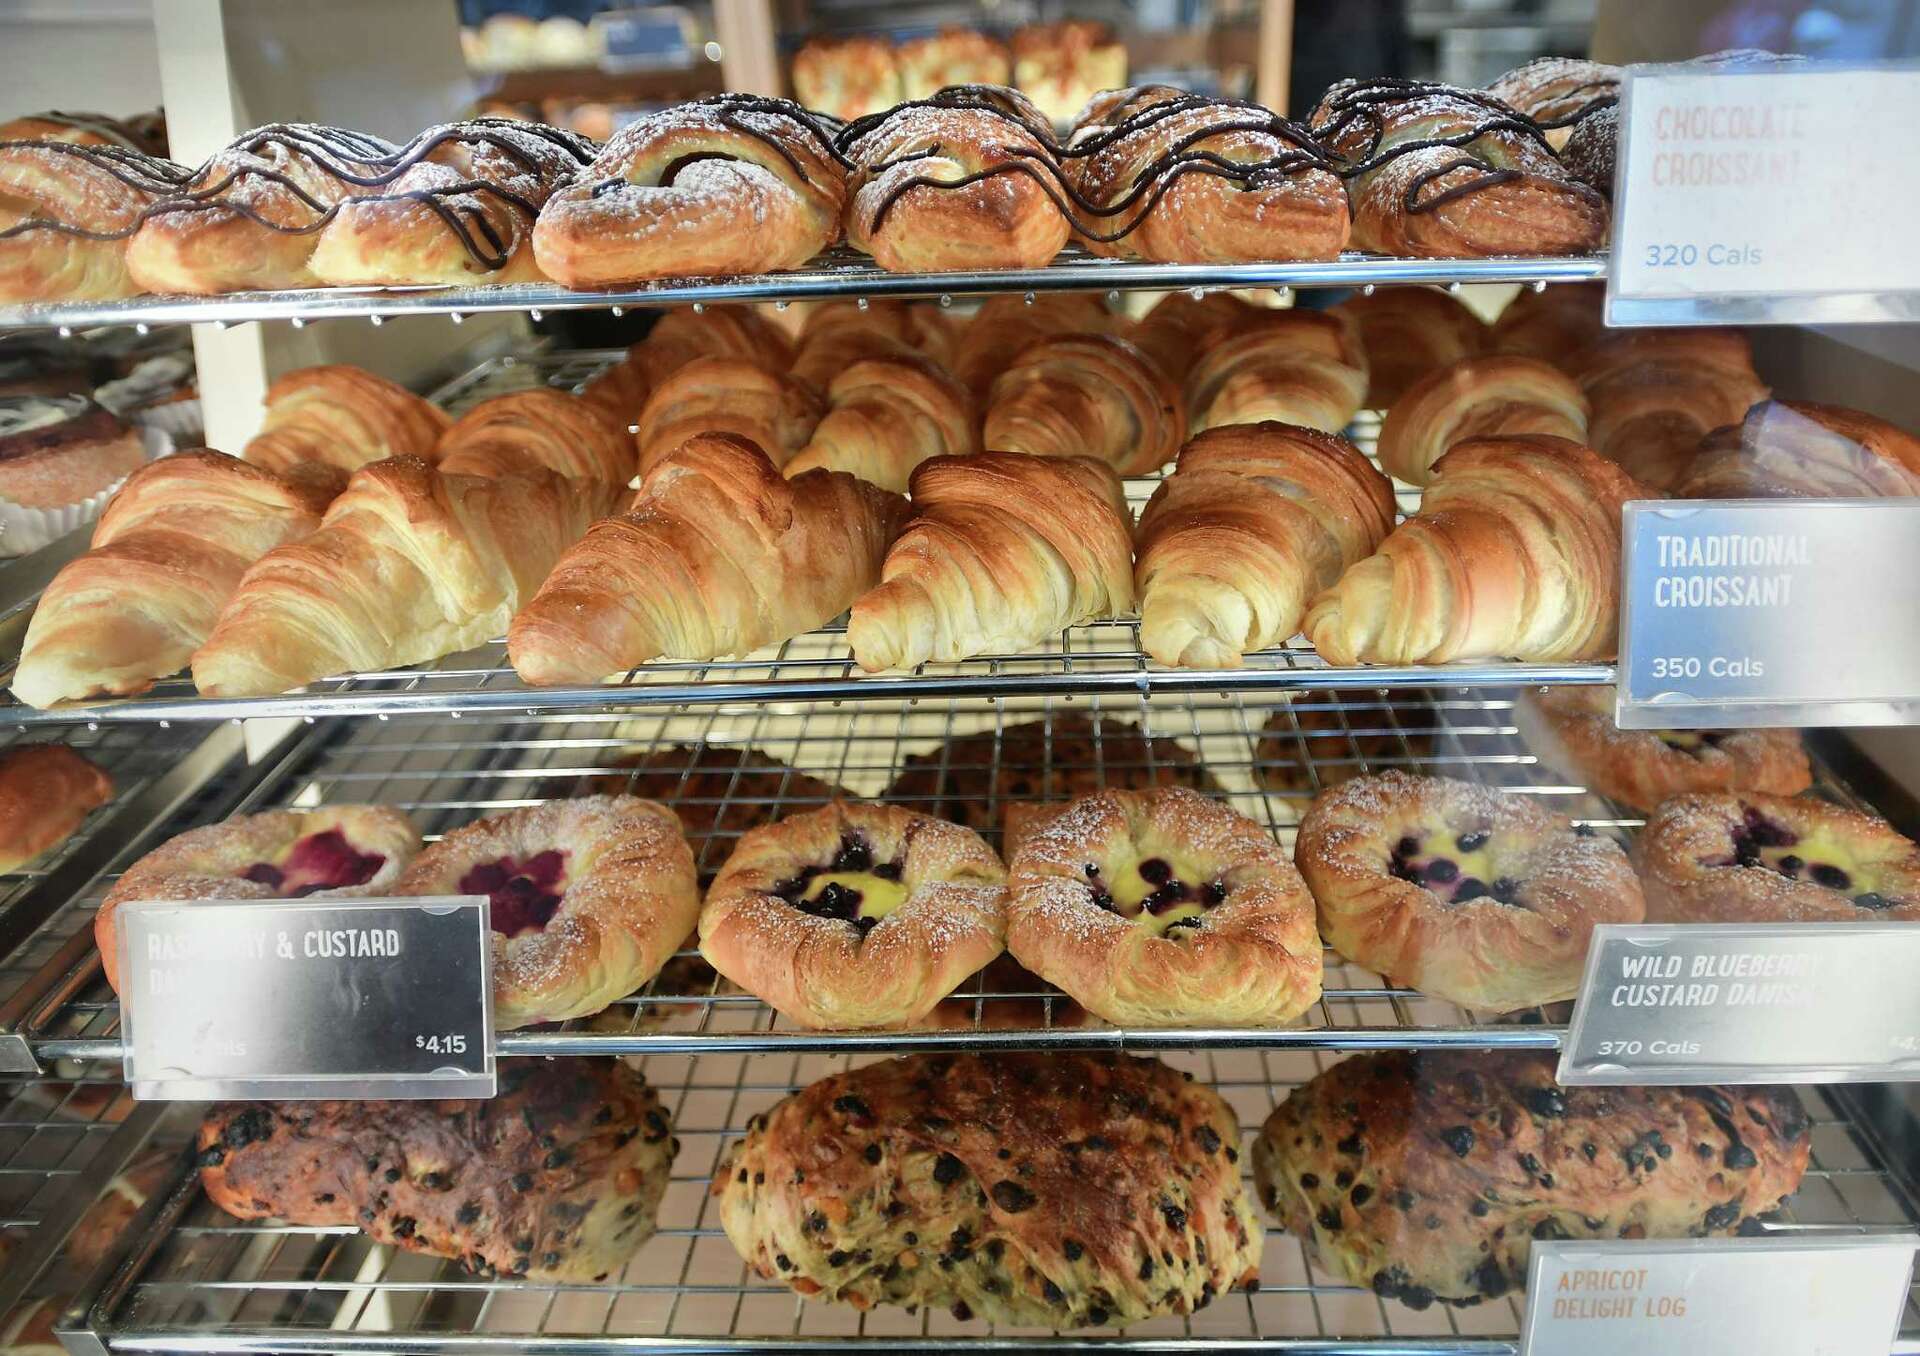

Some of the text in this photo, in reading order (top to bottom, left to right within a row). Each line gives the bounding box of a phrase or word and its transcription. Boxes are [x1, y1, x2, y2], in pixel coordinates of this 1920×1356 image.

[1656, 103, 1806, 141] CHOCOLATE
[1652, 150, 1801, 187] CROISSANT
[1646, 243, 1762, 266] 320 Cals
[1657, 534, 1812, 567] TRADITIONAL
[1655, 574, 1793, 608] CROISSANT
[1652, 656, 1764, 678] 350 Cals
[276, 929, 295, 960] &
[304, 928, 400, 959] CUSTARD
[1622, 955, 1683, 979] WILD
[1611, 982, 1819, 1008] CUSTARD DANIS
[415, 1033, 466, 1055] $4.15
[1597, 1039, 1701, 1056] 370 Cals
[1557, 1268, 1648, 1293] APRICOT
[1552, 1295, 1687, 1320] DELIGHT LOG
